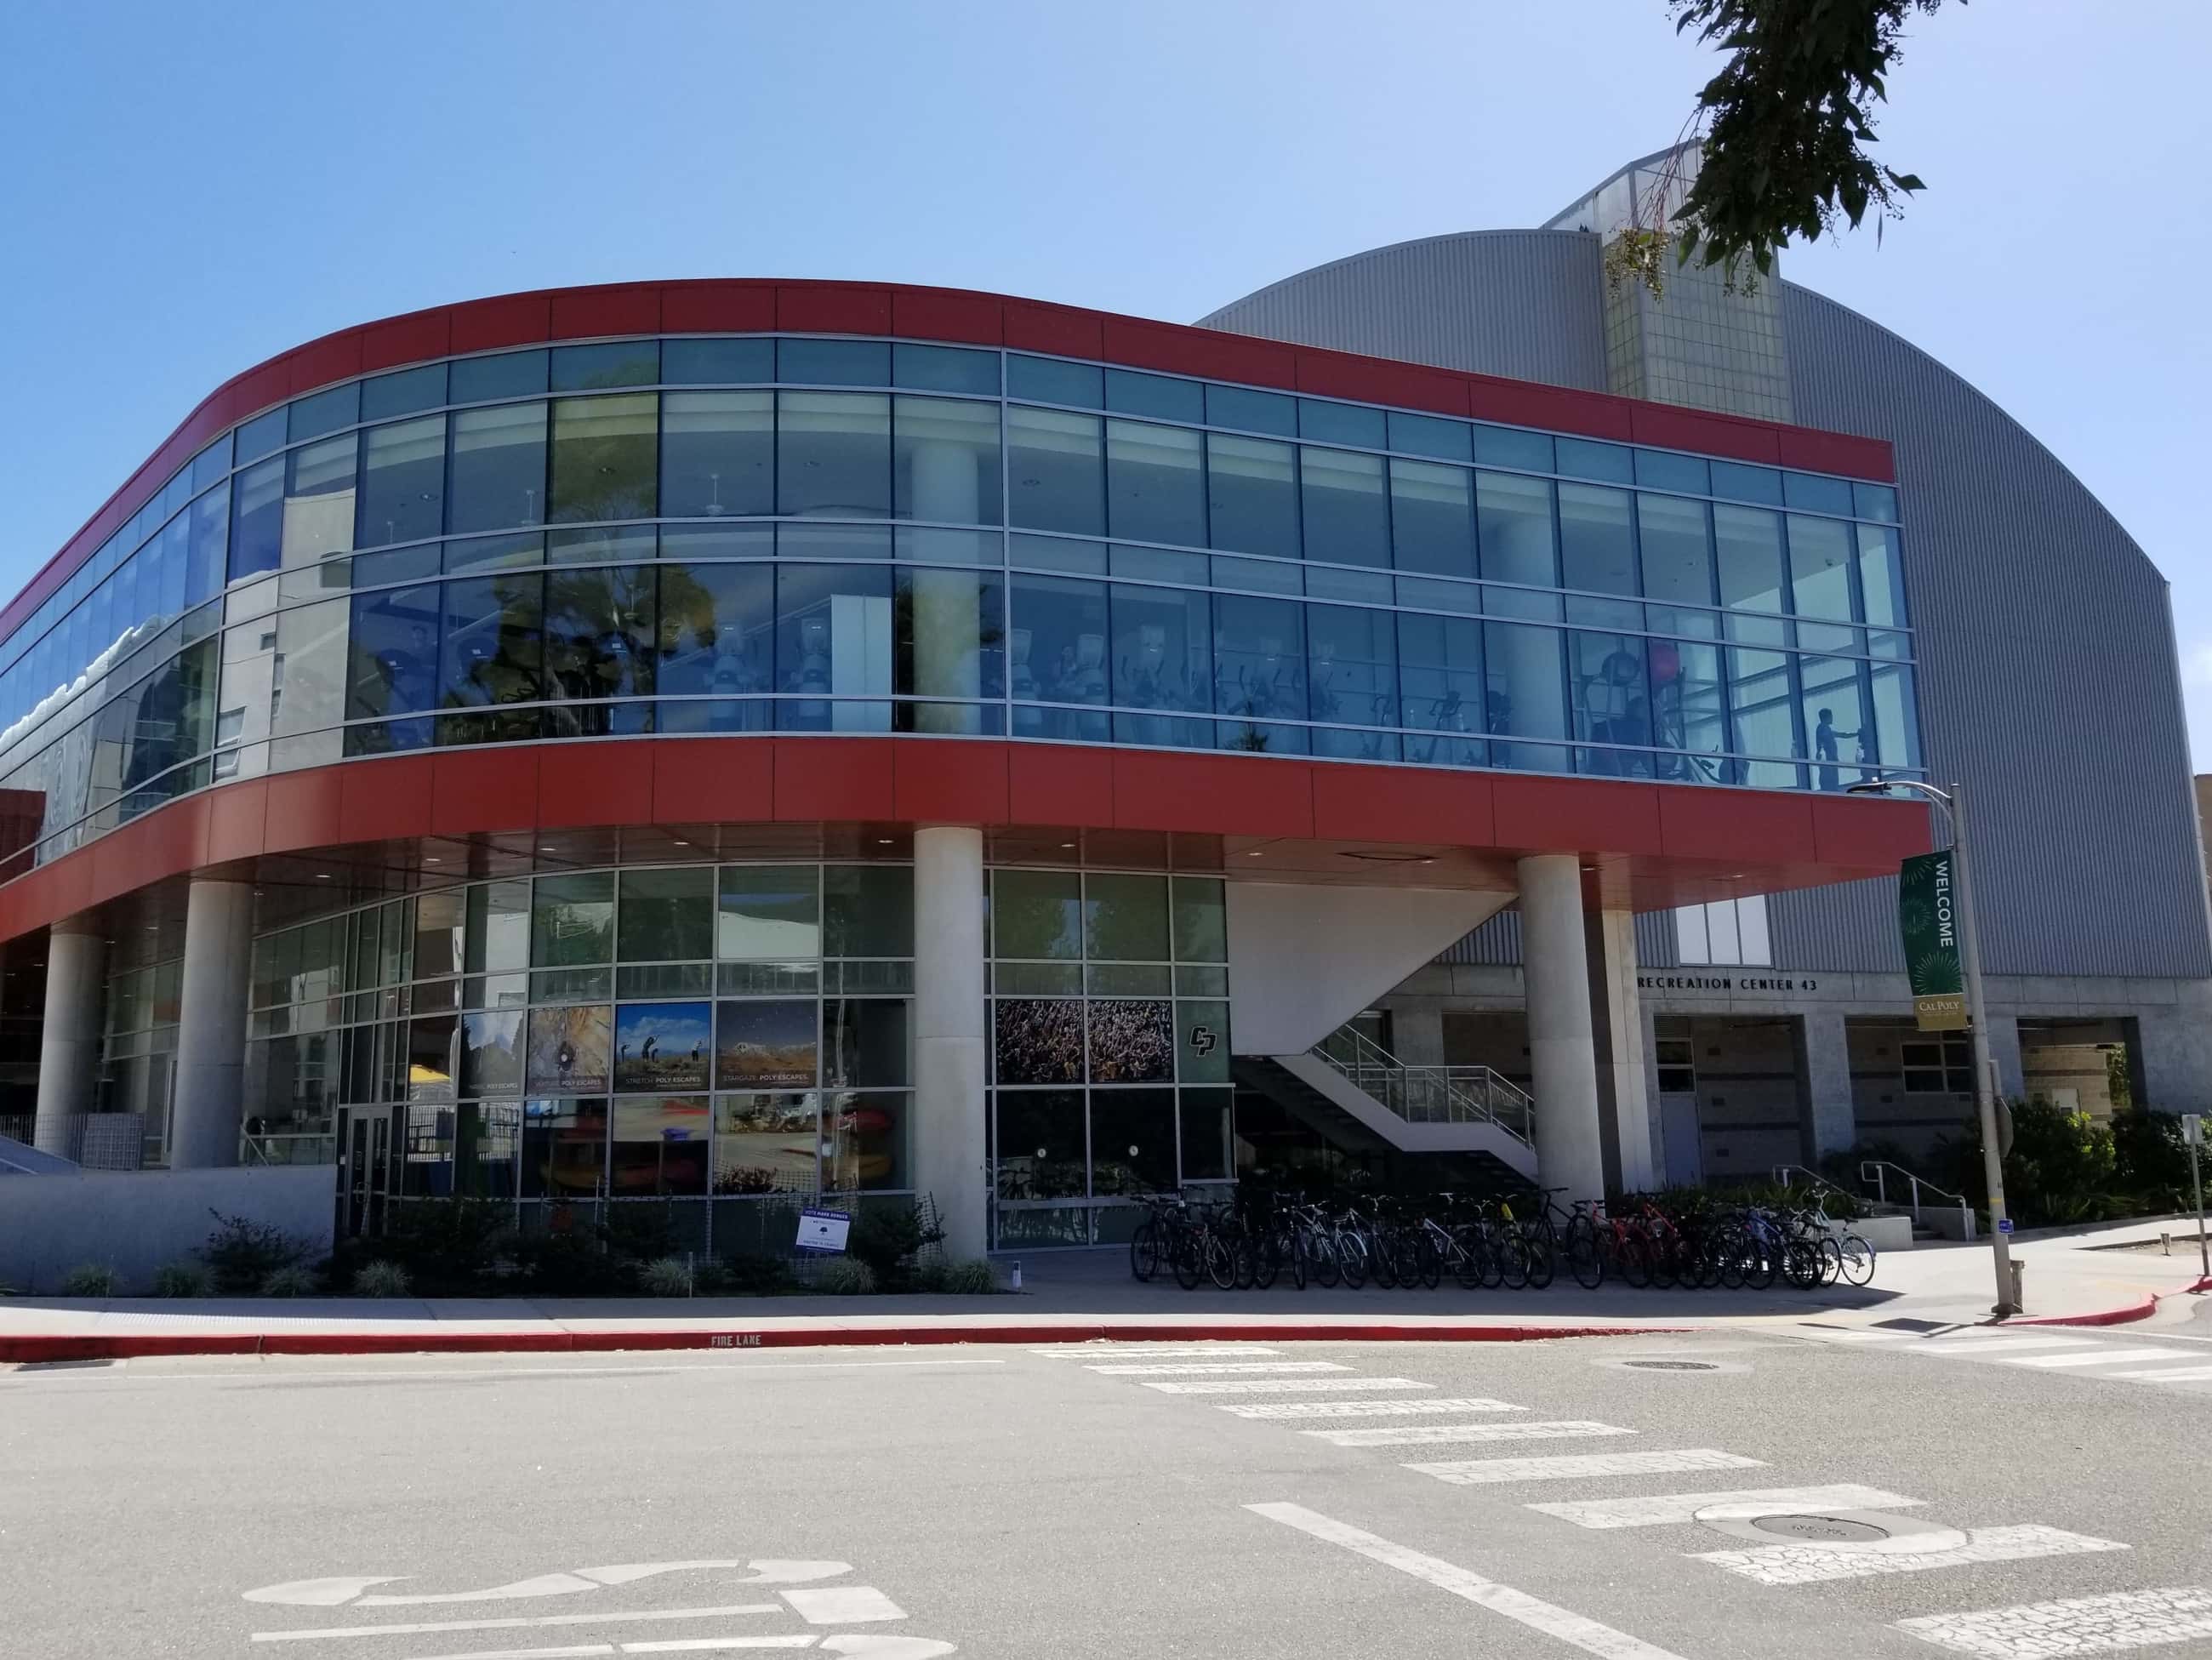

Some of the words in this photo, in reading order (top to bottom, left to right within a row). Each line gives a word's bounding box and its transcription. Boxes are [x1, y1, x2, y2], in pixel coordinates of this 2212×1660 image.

[1935, 860, 1953, 947] WELCOME
[1637, 978, 1731, 990] RECREATION
[1741, 979, 1793, 990] CENTER
[1801, 980, 1817, 990] 43
[711, 1335, 733, 1347] FIRE
[735, 1334, 761, 1346] LANE
